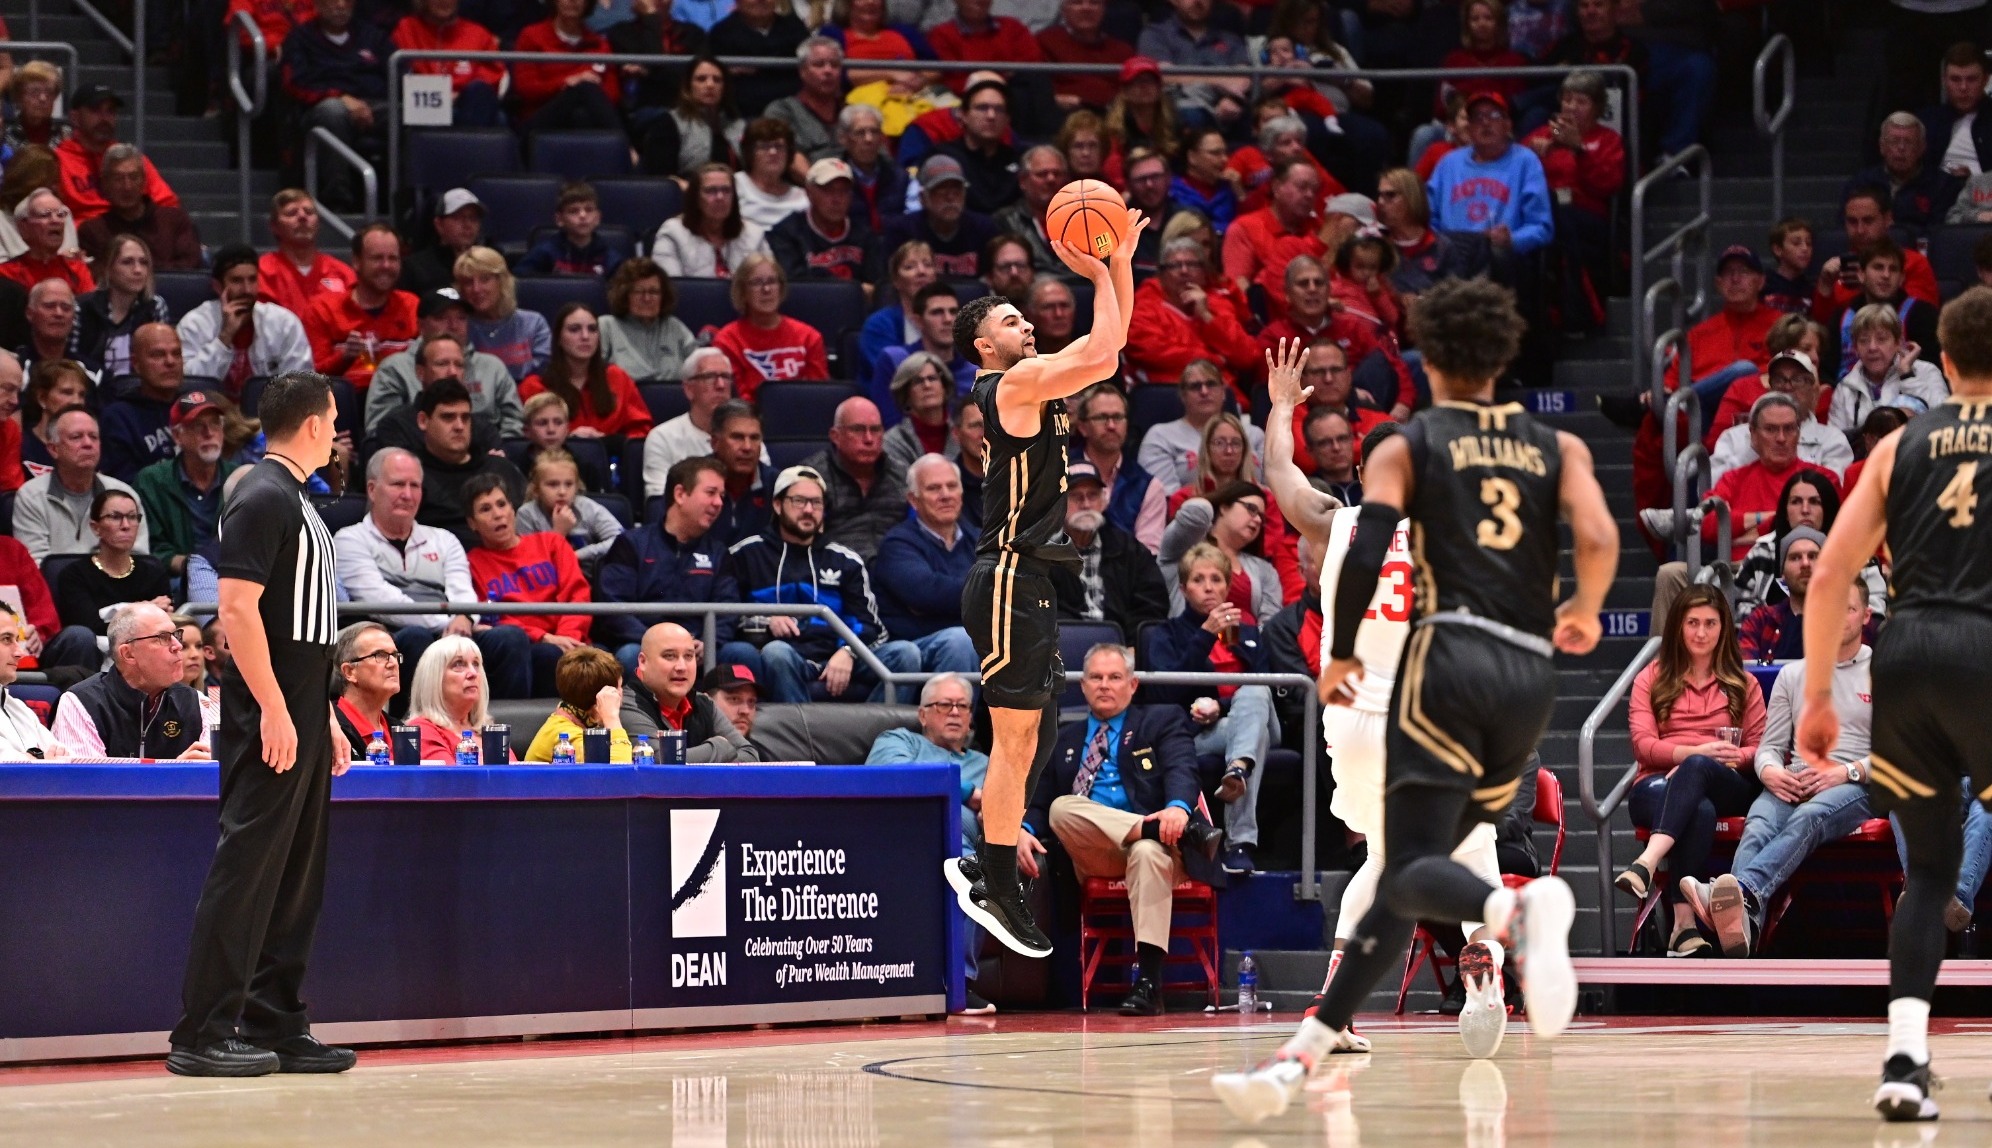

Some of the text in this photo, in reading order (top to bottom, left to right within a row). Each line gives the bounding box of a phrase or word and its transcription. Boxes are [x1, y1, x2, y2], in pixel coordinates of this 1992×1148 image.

[413, 91, 443, 109] 115
[1537, 391, 1565, 411] 115
[1448, 435, 1547, 477] WILLIAMS
[1928, 423, 1992, 459] TRACE
[1936, 461, 1979, 528] 4
[1476, 477, 1524, 550] 3
[1608, 613, 1638, 635] 116
[741, 840, 846, 886] Experience
[741, 885, 878, 921] The Difference
[745, 935, 873, 960] Celebrating Over 50 Years
[671, 952, 727, 988] DEAN
[776, 961, 915, 988] of Pure Wealth Management
